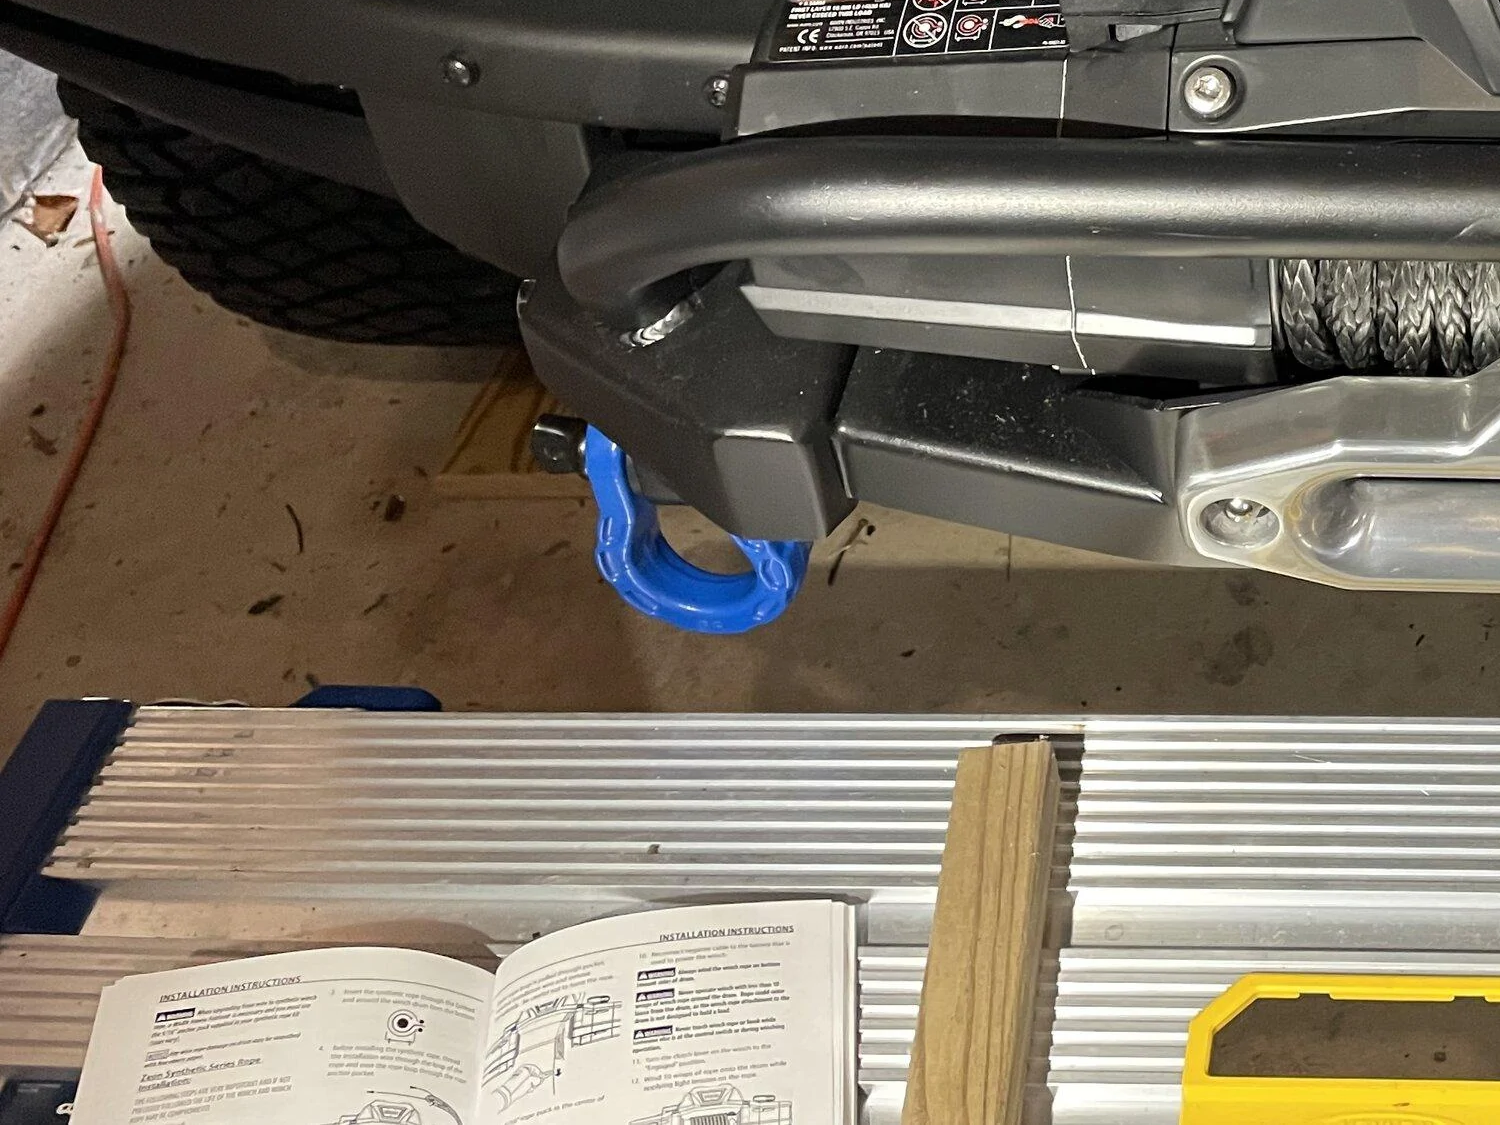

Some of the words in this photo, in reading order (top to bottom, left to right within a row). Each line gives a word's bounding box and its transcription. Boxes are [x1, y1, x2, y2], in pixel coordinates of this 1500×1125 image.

[659, 928, 727, 943] INSTALLATION
[727, 925, 795, 936] INSTRUCTIONS
[159, 985, 228, 1003] INSTALLATION
[229, 975, 301, 993] INSTRUCTIONS
